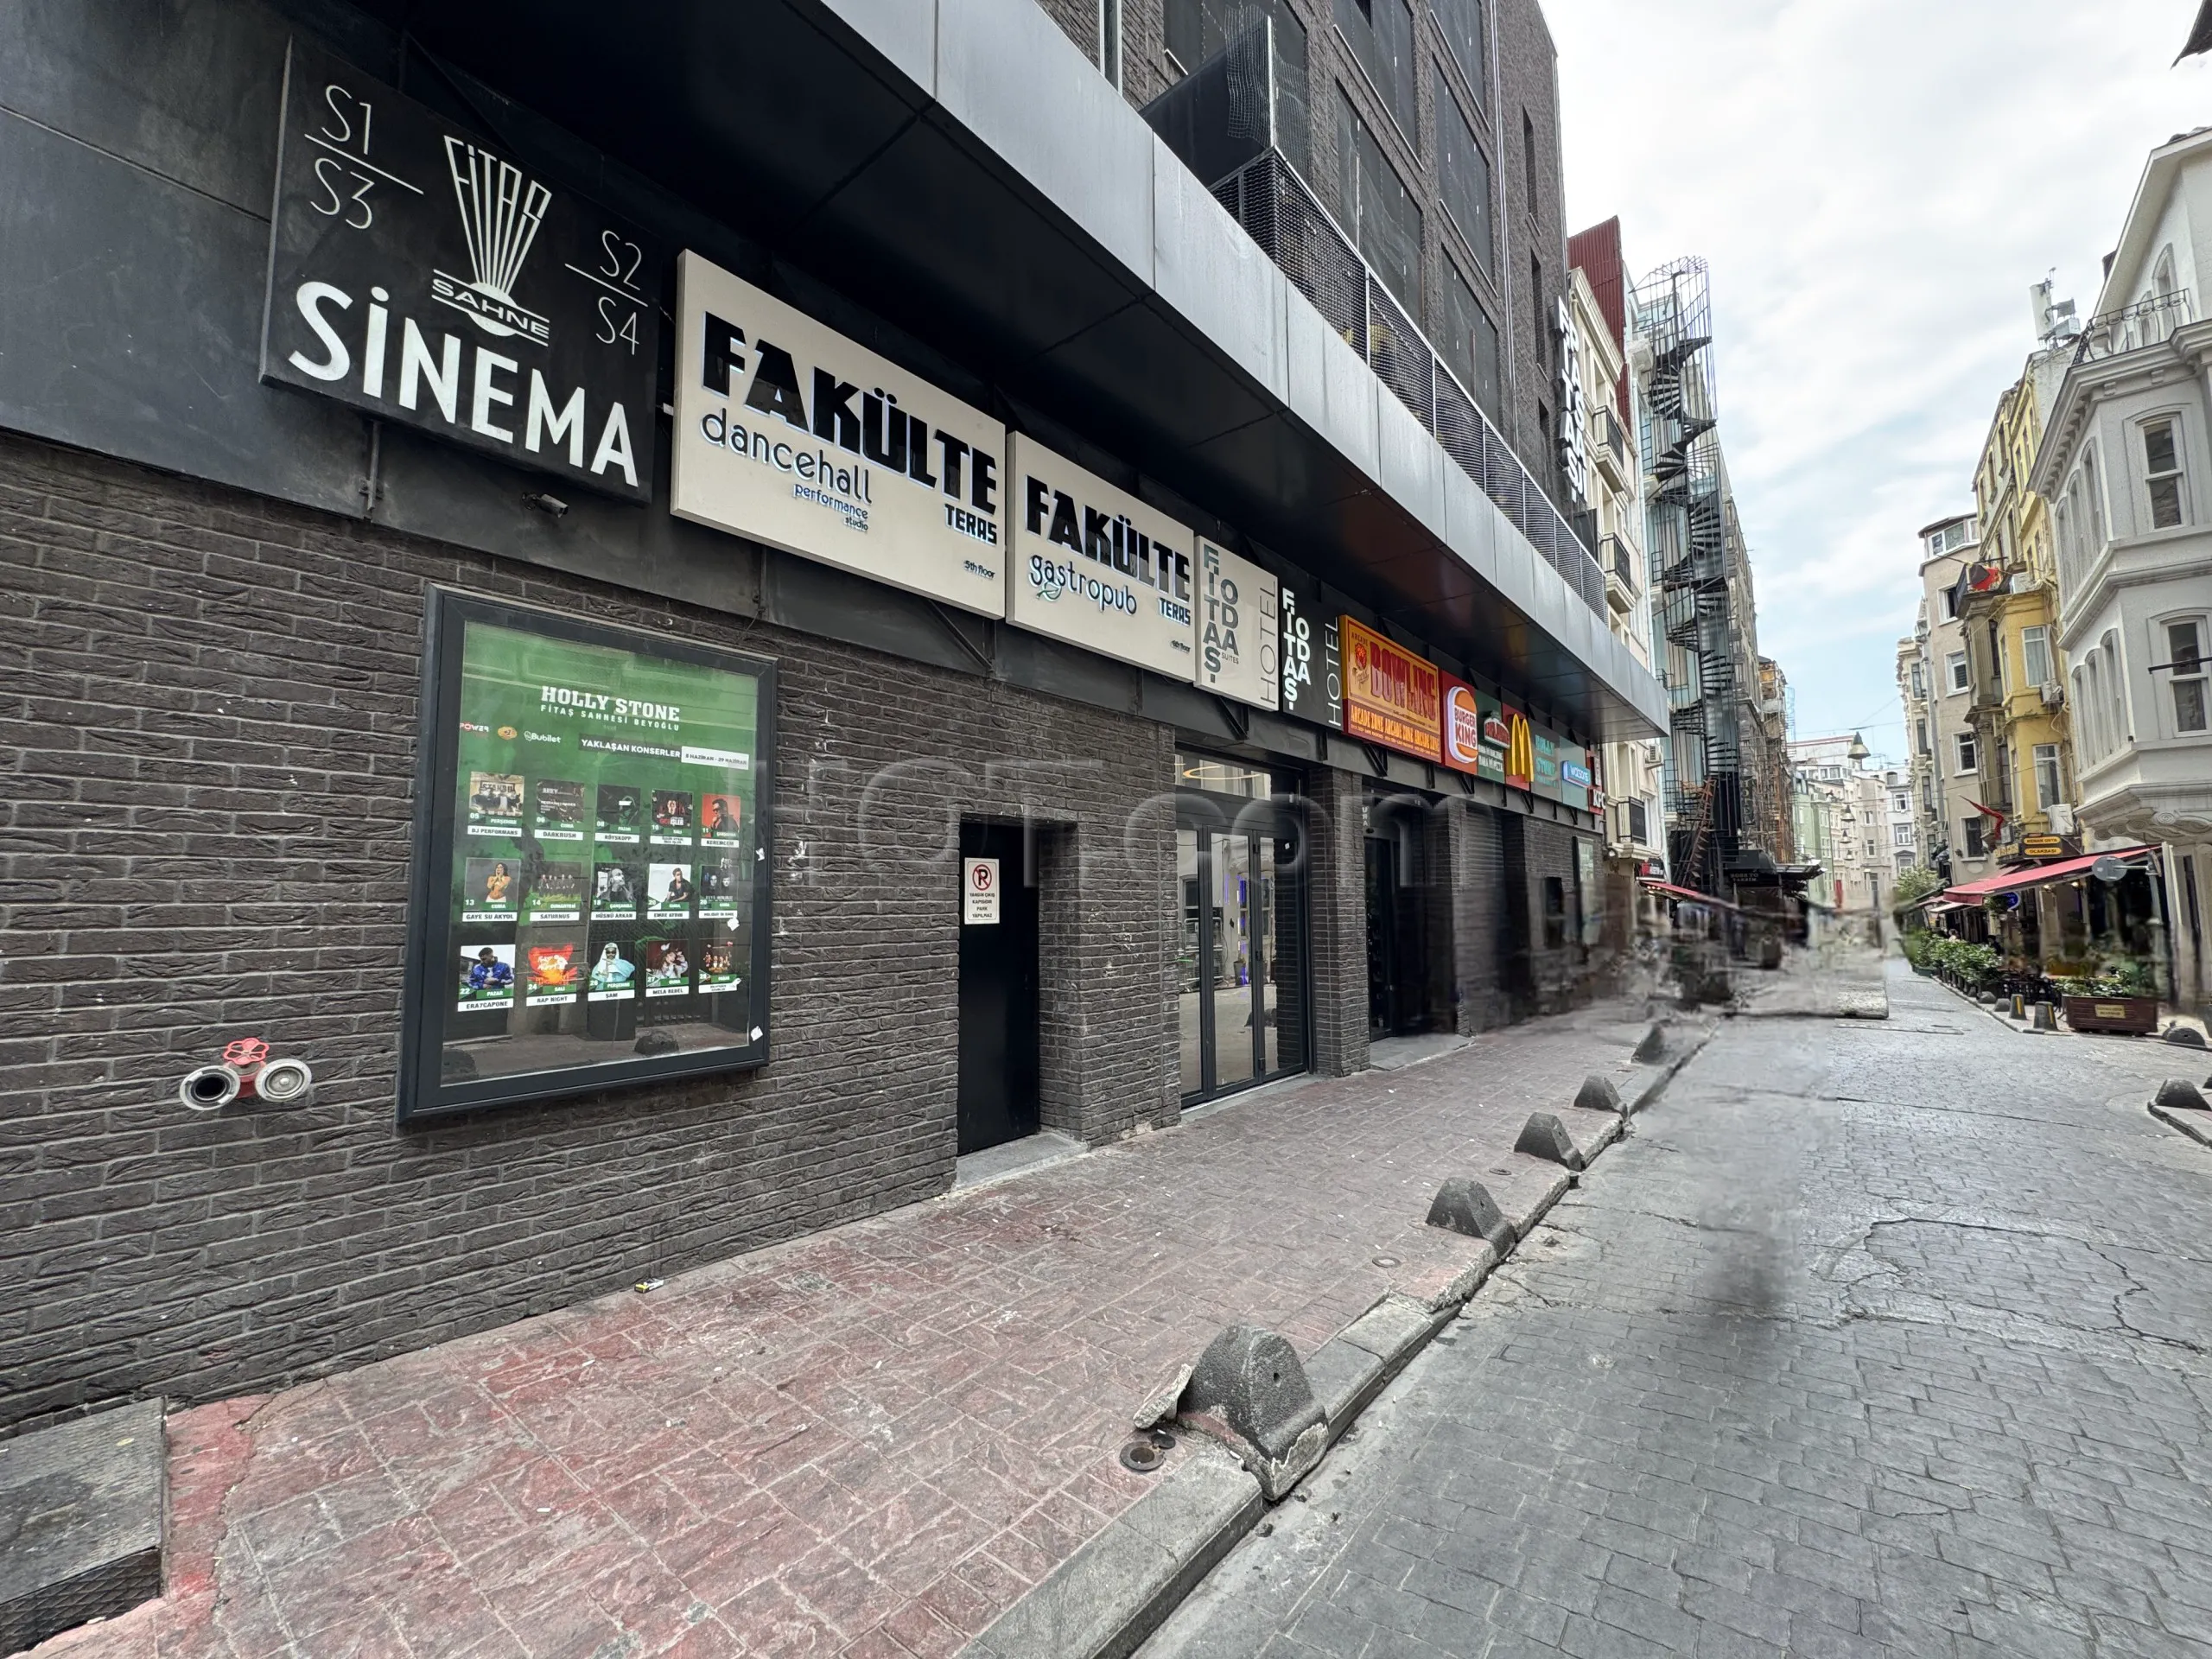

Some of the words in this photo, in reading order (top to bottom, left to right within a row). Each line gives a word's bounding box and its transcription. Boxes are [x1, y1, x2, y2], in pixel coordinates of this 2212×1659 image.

[321, 85, 372, 155] S1
[310, 158, 375, 229] S3
[600, 230, 641, 290] S2
[432, 277, 550, 340] SAHNE
[595, 296, 639, 355] S4
[702, 310, 997, 517] FAKÜLTE
[701, 408, 872, 505] dancehall
[793, 483, 868, 521] performance
[844, 516, 868, 532] studio
[944, 503, 997, 547] TERAS
[1026, 474, 1191, 603] FAKÜLTE
[963, 560, 977, 573] 5th
[977, 563, 995, 579] floor
[1028, 554, 1137, 615] gastropub
[1158, 597, 1191, 626] TERAS
[1221, 652, 1240, 664] SUITES
[1260, 581, 1276, 704] HOTEL
[1351, 632, 1369, 646] ARCADE
[1325, 617, 1342, 727] HOTEL
[1370, 641, 1437, 721] BOWLING
[540, 704, 574, 717] FİTAŞ
[581, 710, 627, 724] SAHNESİ
[634, 718, 679, 731] BEYOĞLU
[541, 686, 609, 710] HOLLY
[615, 698, 680, 721] STONE
[1454, 708, 1476, 725] BURGER
[531, 733, 561, 744] Bubilet
[581, 739, 630, 753] YAKLAŞAN
[631, 745, 681, 759] KONSERLER
[1455, 723, 1477, 748] KING
[1592, 790, 1606, 810] KFC
[466, 1001, 509, 1009] ERA7CAPONE
